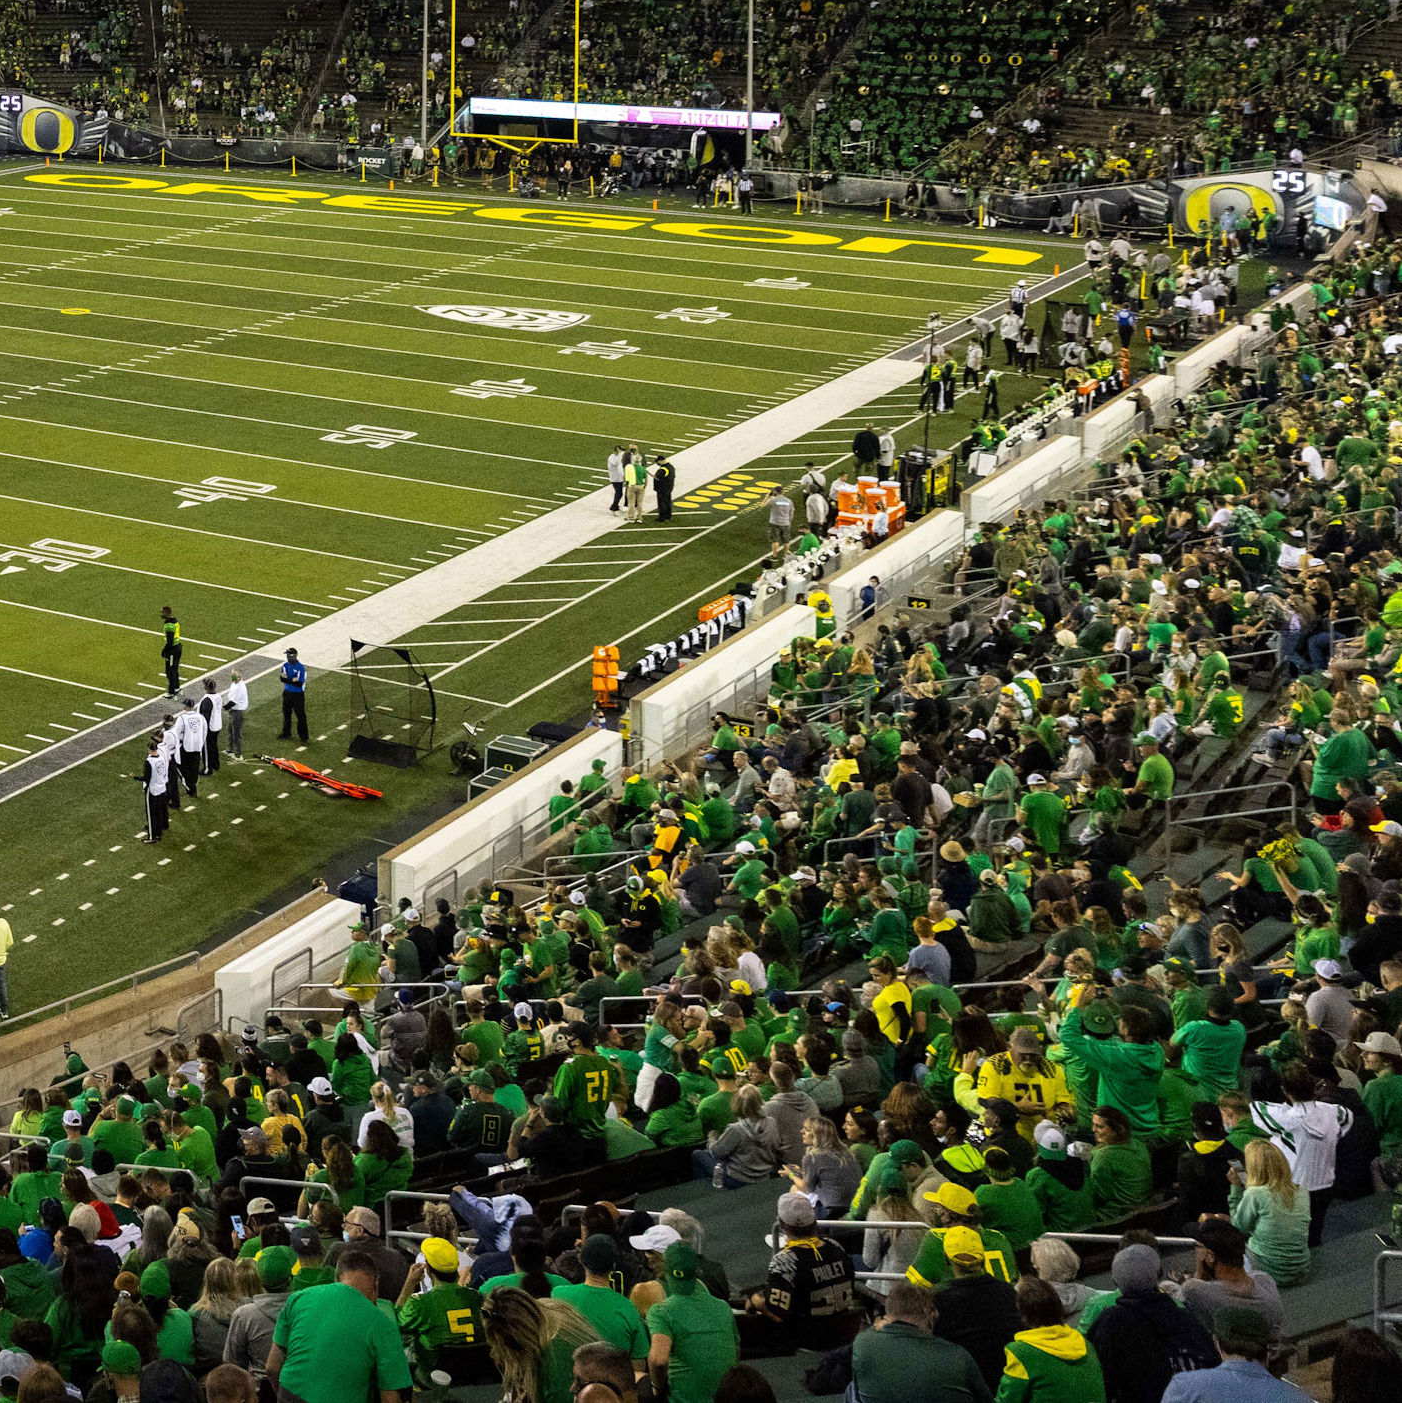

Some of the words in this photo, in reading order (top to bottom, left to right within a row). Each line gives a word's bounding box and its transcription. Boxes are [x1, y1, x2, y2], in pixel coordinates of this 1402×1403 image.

[0, 94, 22, 111] 25
[22, 107, 75, 154] O
[357, 156, 386, 165] ROCKET
[1272, 171, 1305, 193] 25
[23, 173, 1043, 266] OREGON
[1186, 182, 1277, 241] O
[60, 308, 91, 316] O
[447, 379, 538, 399] 40
[318, 424, 419, 449] 50
[172, 476, 278, 502] 40
[910, 601, 928, 610] 12
[733, 724, 752, 737] 13
[723, 1046, 748, 1074] 10
[585, 1069, 609, 1103] 21
[812, 1259, 846, 1284] PAULEY
[767, 1288, 791, 1311] 29
[446, 1307, 475, 1343] 5
